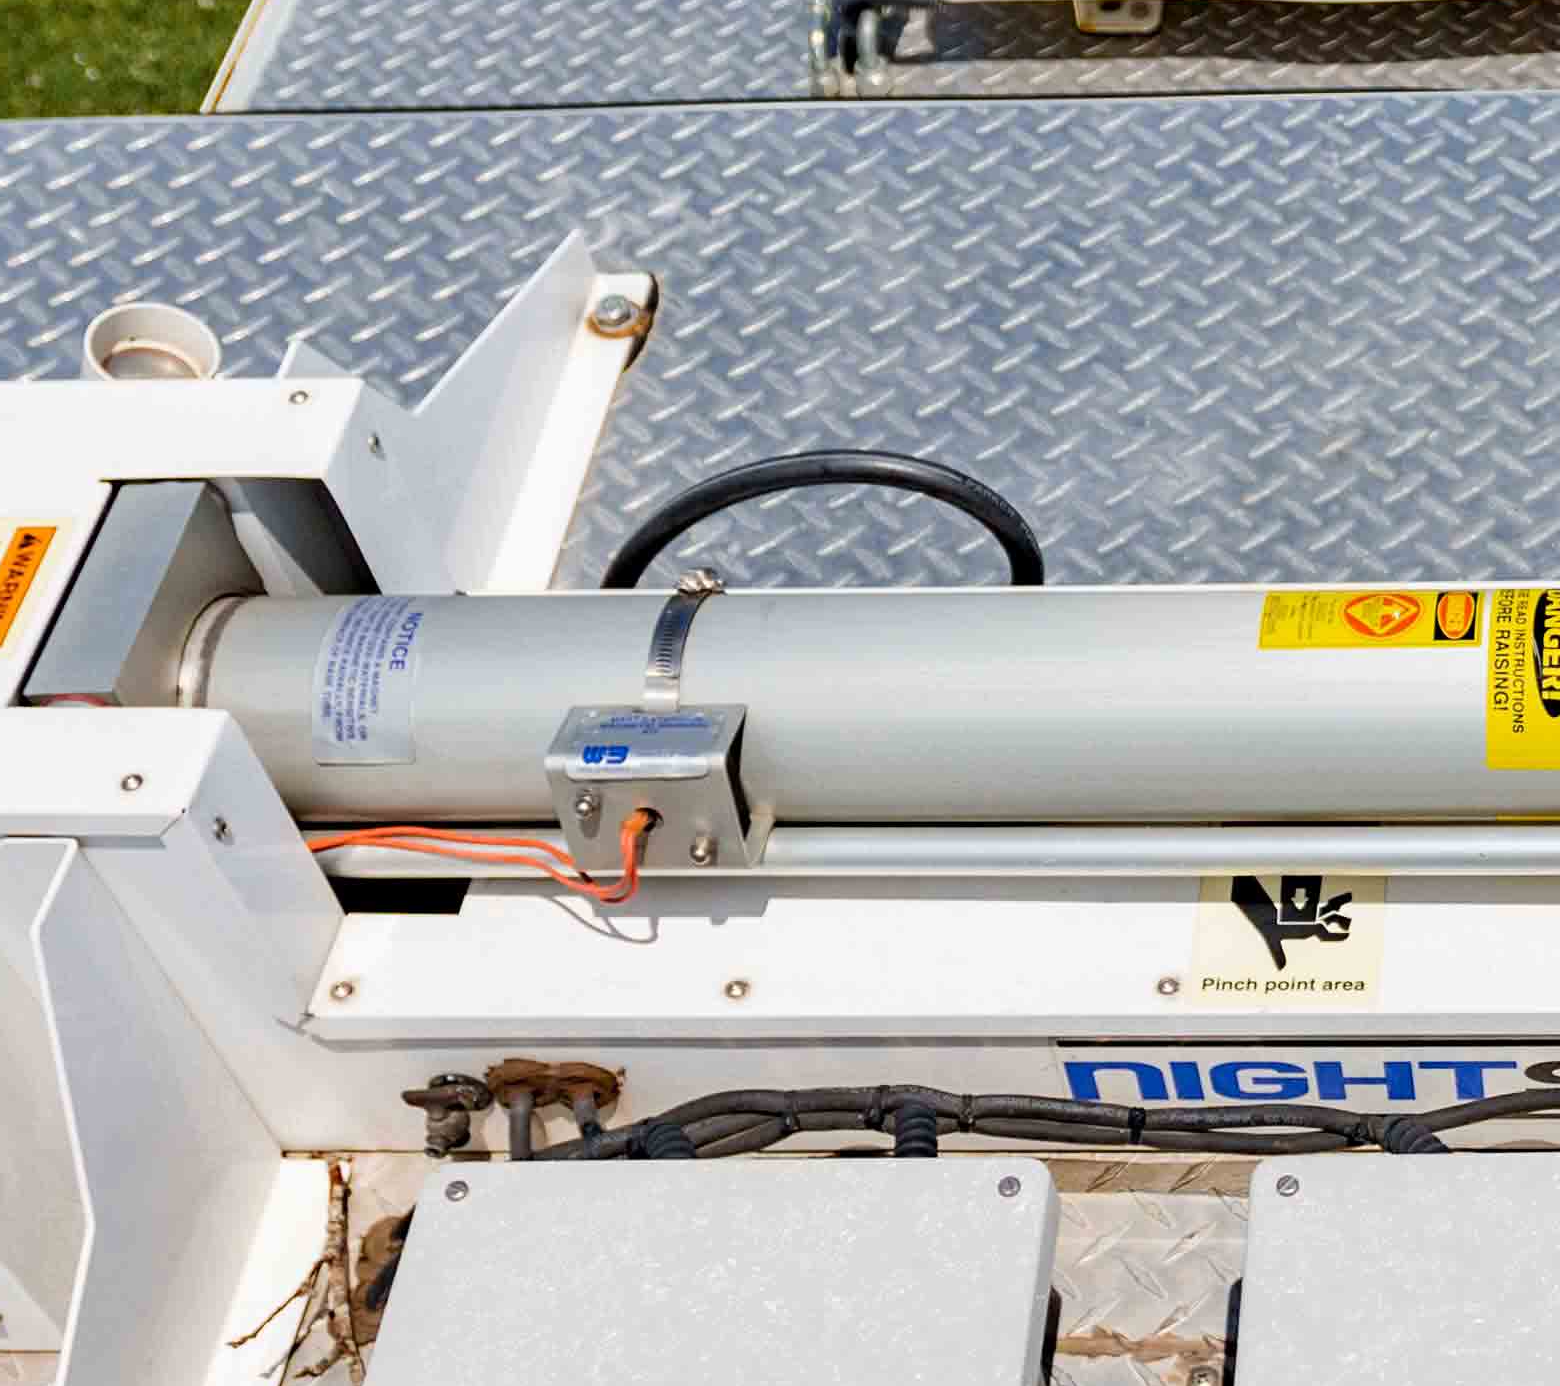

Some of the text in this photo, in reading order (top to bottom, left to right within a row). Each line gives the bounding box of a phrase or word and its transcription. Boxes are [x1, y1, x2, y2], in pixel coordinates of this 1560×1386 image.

[390, 612, 425, 670] NOTICE
[1514, 601, 1528, 625] READ
[1494, 629, 1511, 711] RAISING!
[1512, 629, 1527, 734] INSTRUCTIONS
[1201, 977, 1366, 994] Pinch point area
